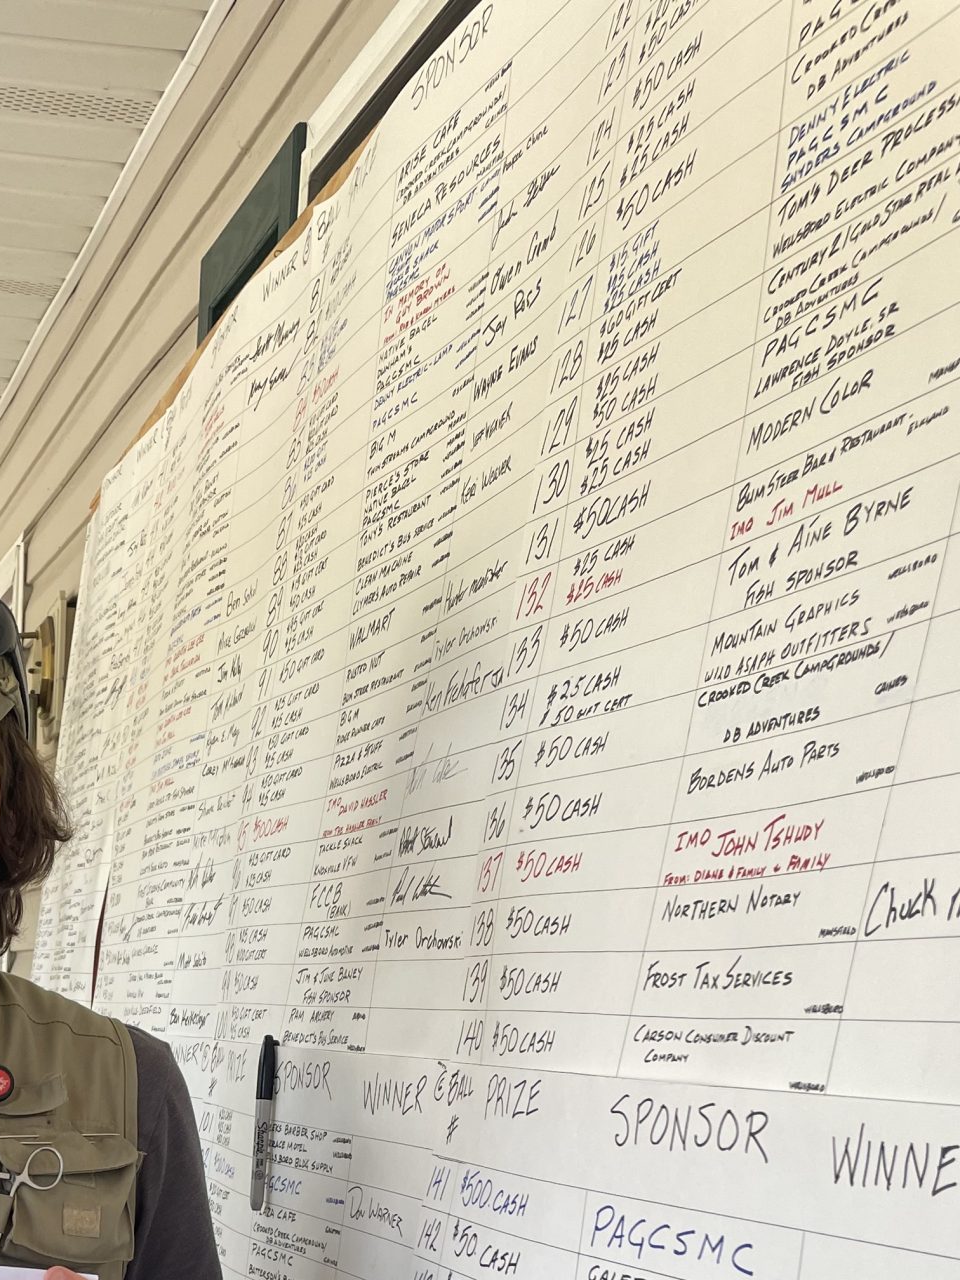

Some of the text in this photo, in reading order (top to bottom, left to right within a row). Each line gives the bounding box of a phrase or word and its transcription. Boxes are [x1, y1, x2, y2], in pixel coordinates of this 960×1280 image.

[411, 4, 494, 110] SPONSOR
[807, 11, 909, 100] DB ADVENTURES
[788, 50, 910, 149] DENNY ELECTRIC
[778, 94, 960, 226] TOM'S DEER PROCESS
[781, 81, 937, 193] SNYDERS CAMPGROUND
[652, 149, 698, 202] CASH
[767, 248, 828, 294] CENTURY
[753, 348, 822, 399] LAWRENCE
[878, 302, 899, 324] SR
[747, 369, 874, 455] MODERN COLOR
[766, 499, 794, 526] JIM
[802, 481, 844, 508] MULL
[526, 518, 559, 564] 131
[729, 547, 759, 586] TOM
[844, 486, 914, 536] BYRNE
[516, 571, 551, 620] 132
[744, 550, 859, 608] FISH SPONSOR
[350, 607, 395, 650] WALMART
[594, 606, 630, 638] CASH
[711, 590, 860, 656] MOUNTAIN GRAPHICS
[736, 650, 776, 674] ASAPH
[781, 617, 872, 659] OUTFITTERS
[604, 694, 632, 712] CERT
[698, 681, 751, 708] CROOKED
[754, 670, 790, 694] CREEK
[688, 740, 840, 794] BORDENS AUTO PARTS
[562, 792, 603, 821] CASH
[675, 814, 824, 858] IMO JOHN TSHUDY
[546, 852, 583, 876] CASH
[662, 884, 801, 922] NORTHERN NOTARY
[384, 927, 409, 949] Tyler
[643, 955, 793, 991] FROST TAX SERVICES
[457, 1018, 483, 1056] 140
[633, 1025, 795, 1046] CARSON CONSUMER DISCOUNT
[644, 1049, 690, 1063] COMPANY
[363, 1072, 427, 1117] WINNER
[485, 1074, 541, 1120] PRIZE
[610, 1094, 769, 1163] SPONSOR
[426, 1166, 450, 1200] 141
[591, 1205, 754, 1277] PAGCSMC
